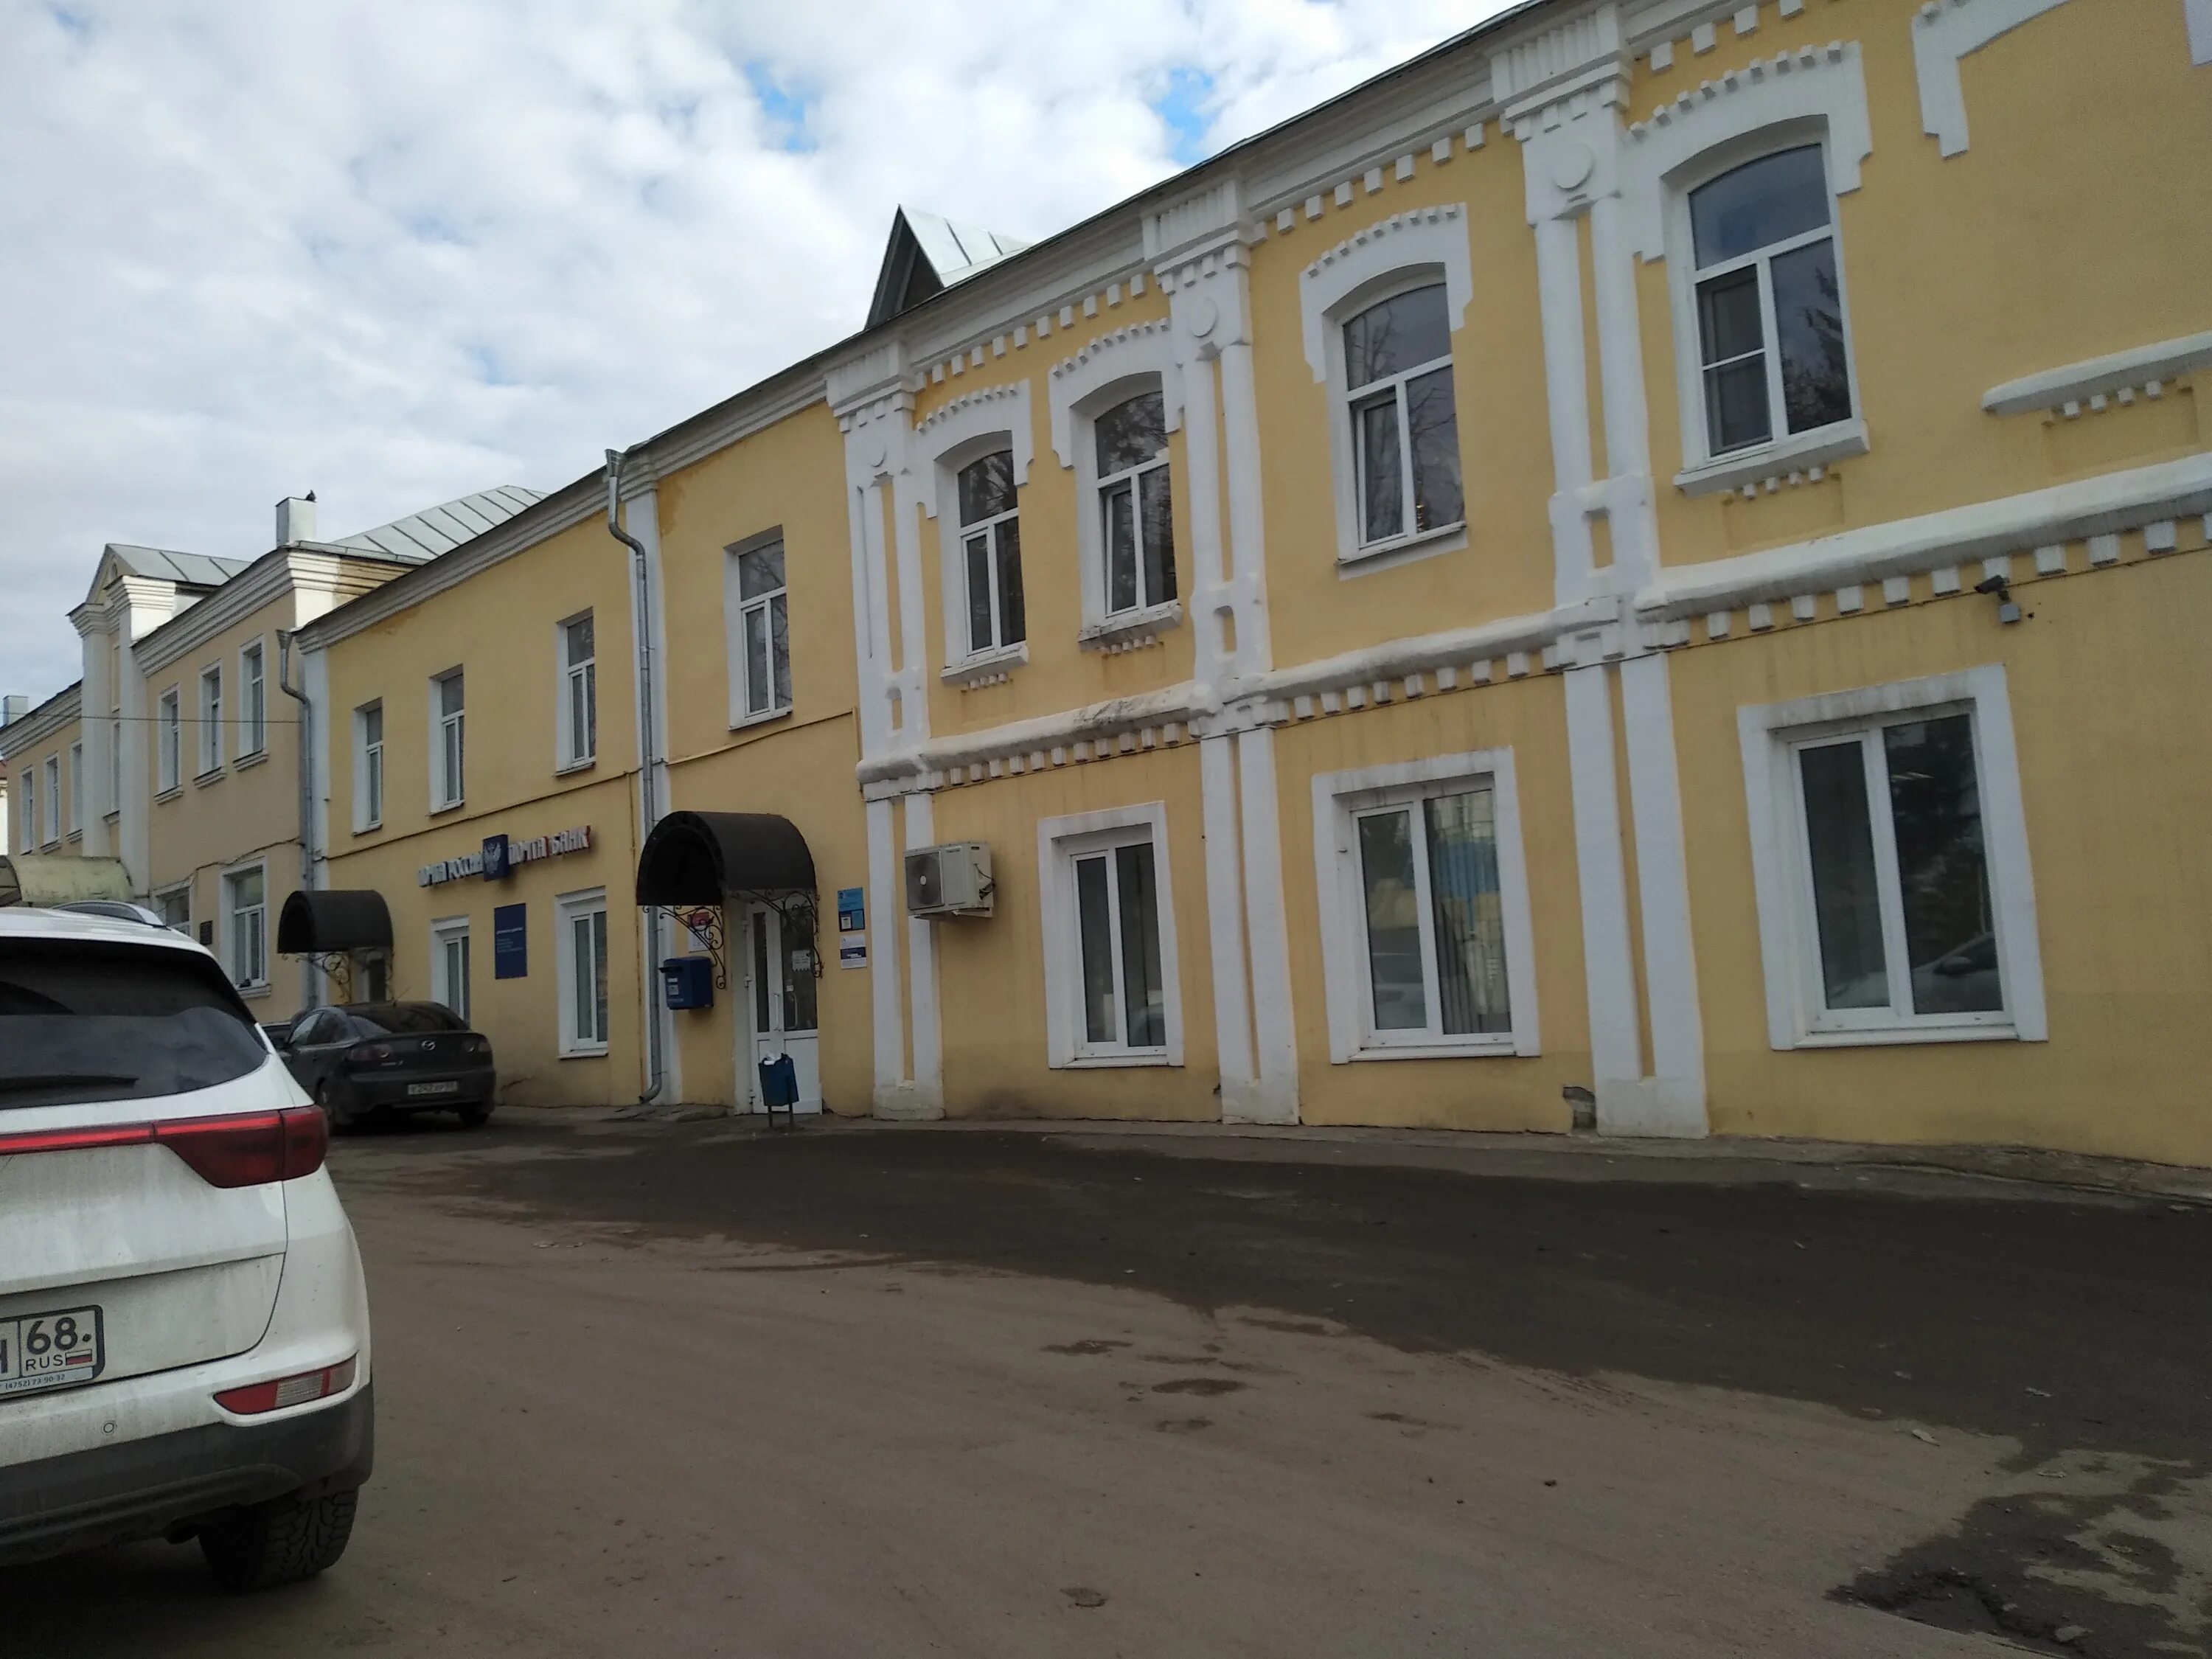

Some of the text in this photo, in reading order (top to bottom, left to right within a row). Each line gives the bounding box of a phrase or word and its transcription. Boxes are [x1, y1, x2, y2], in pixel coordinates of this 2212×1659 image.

[509, 825, 591, 865] ПОЧТА БАНК
[27, 1317, 77, 1355] 68
[26, 1354, 63, 1371] RUS
[5, 1380, 30, 1390] (4752)
